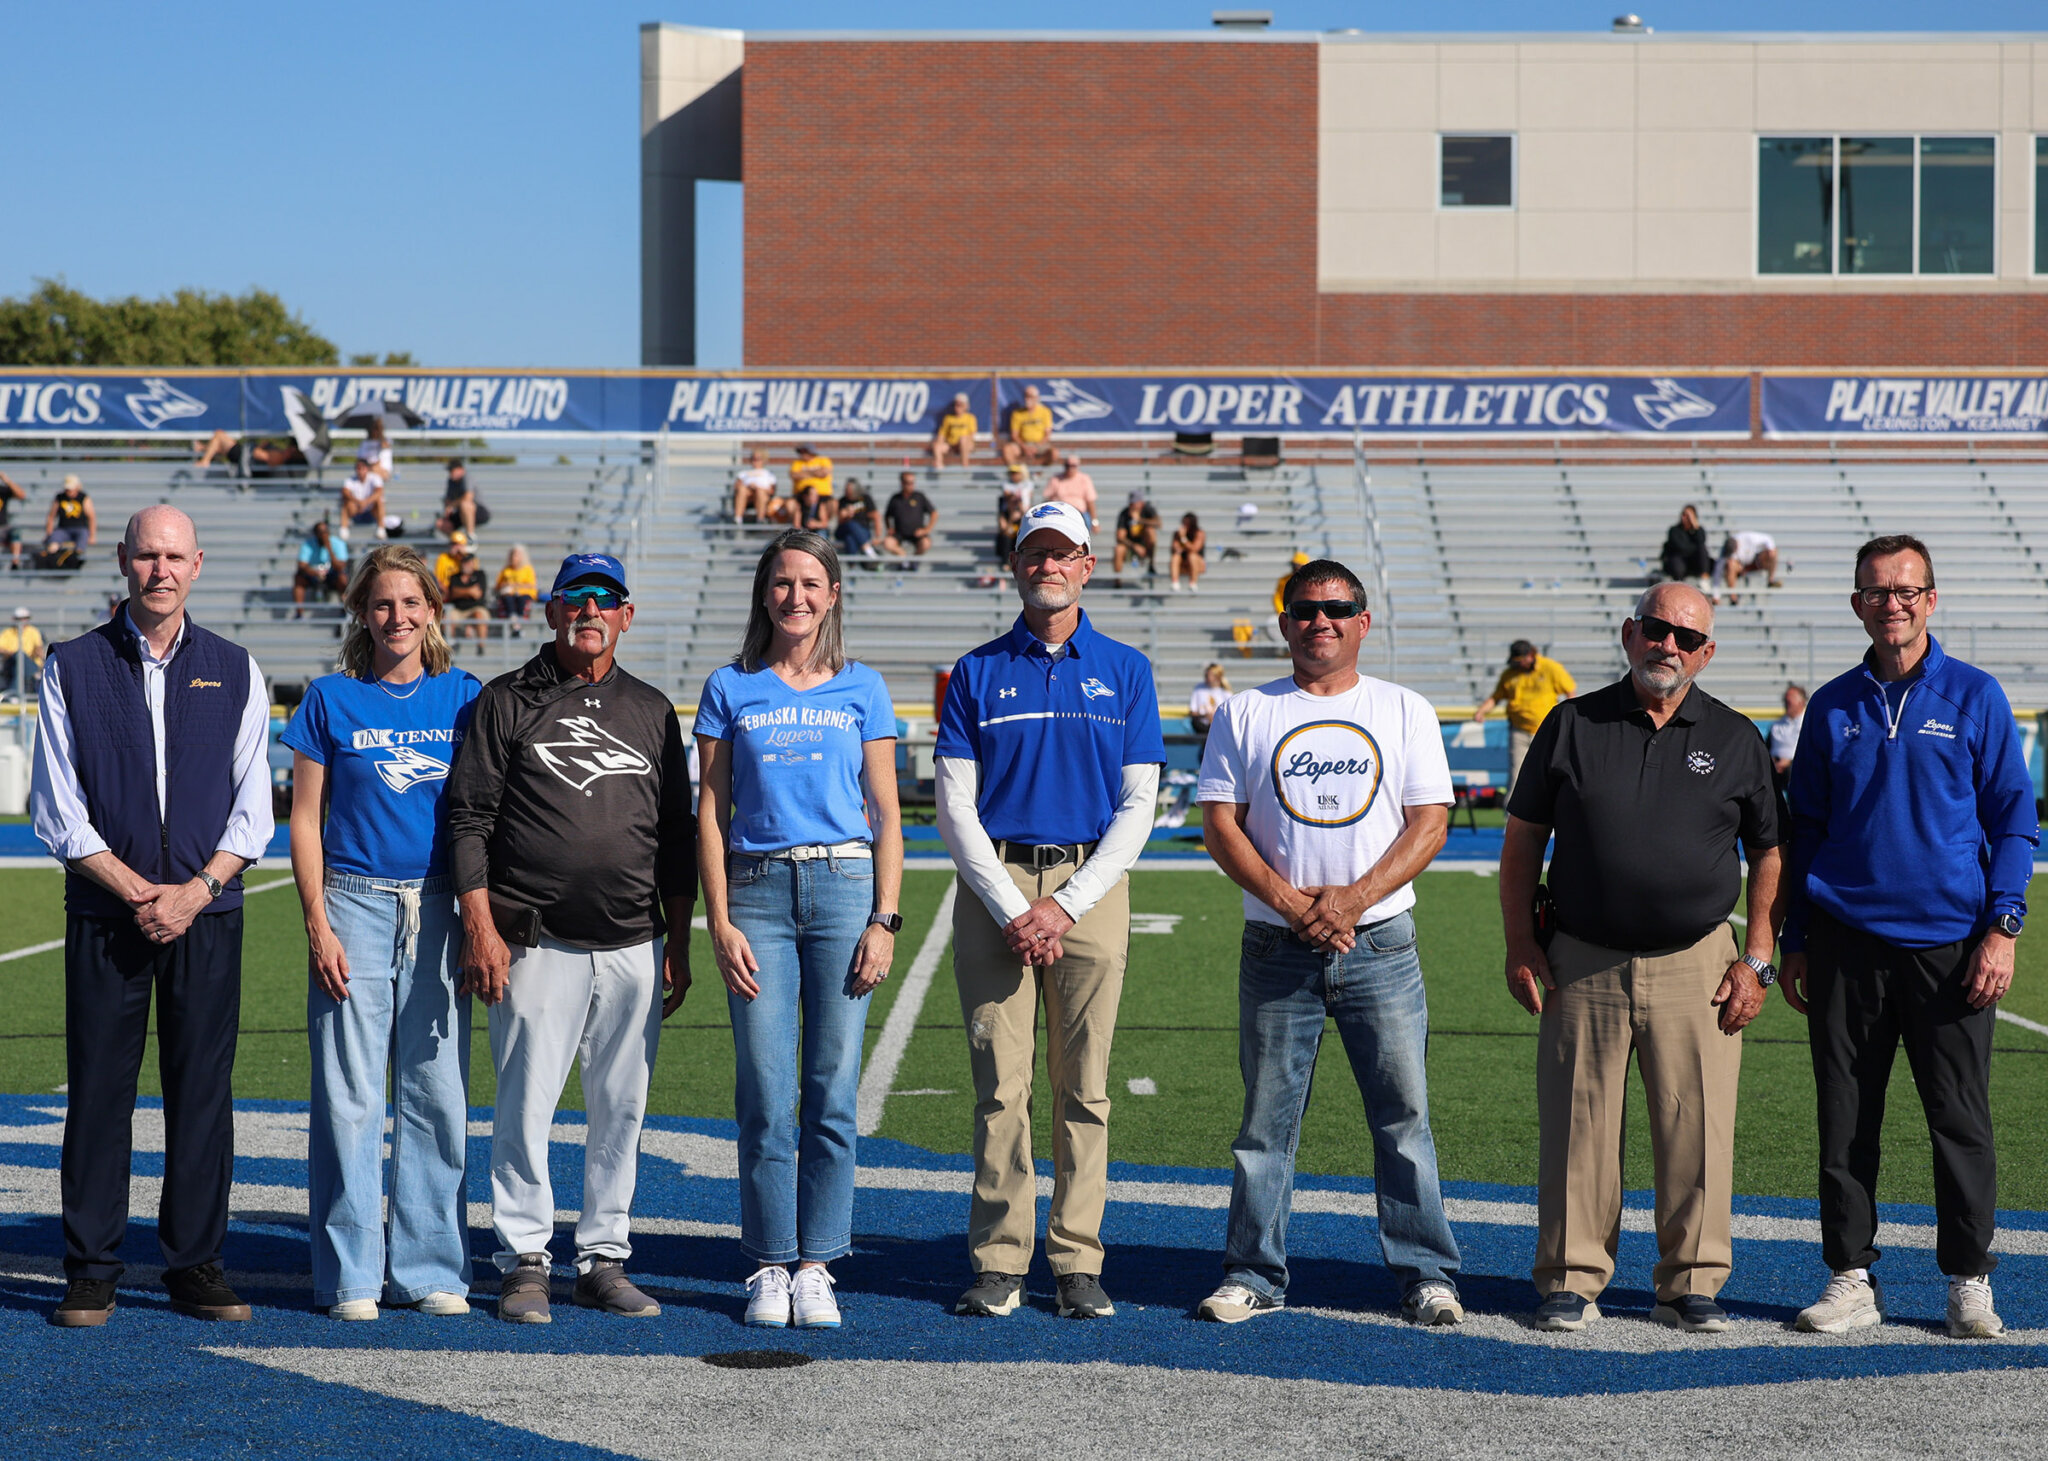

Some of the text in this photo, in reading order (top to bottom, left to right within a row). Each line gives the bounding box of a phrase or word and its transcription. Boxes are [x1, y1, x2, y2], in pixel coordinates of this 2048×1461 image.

[406, 378, 500, 421] VALLEY
[496, 378, 568, 421] AUTO
[668, 380, 930, 424] PLATTE VALLEY AUTO
[1136, 384, 1610, 426] LOPER ATHLETICS
[1825, 379, 1925, 422] PLATTE
[1923, 380, 2021, 420] VALLEY
[704, 417, 882, 432] LEXINGTON KEARNEY
[1862, 416, 2042, 431] LEXINGTON KEARNEY
[800, 707, 855, 732] KEARNEY
[352, 728, 395, 750] UNK
[764, 727, 824, 747] Lopers
[1282, 751, 1370, 785] Lopers
